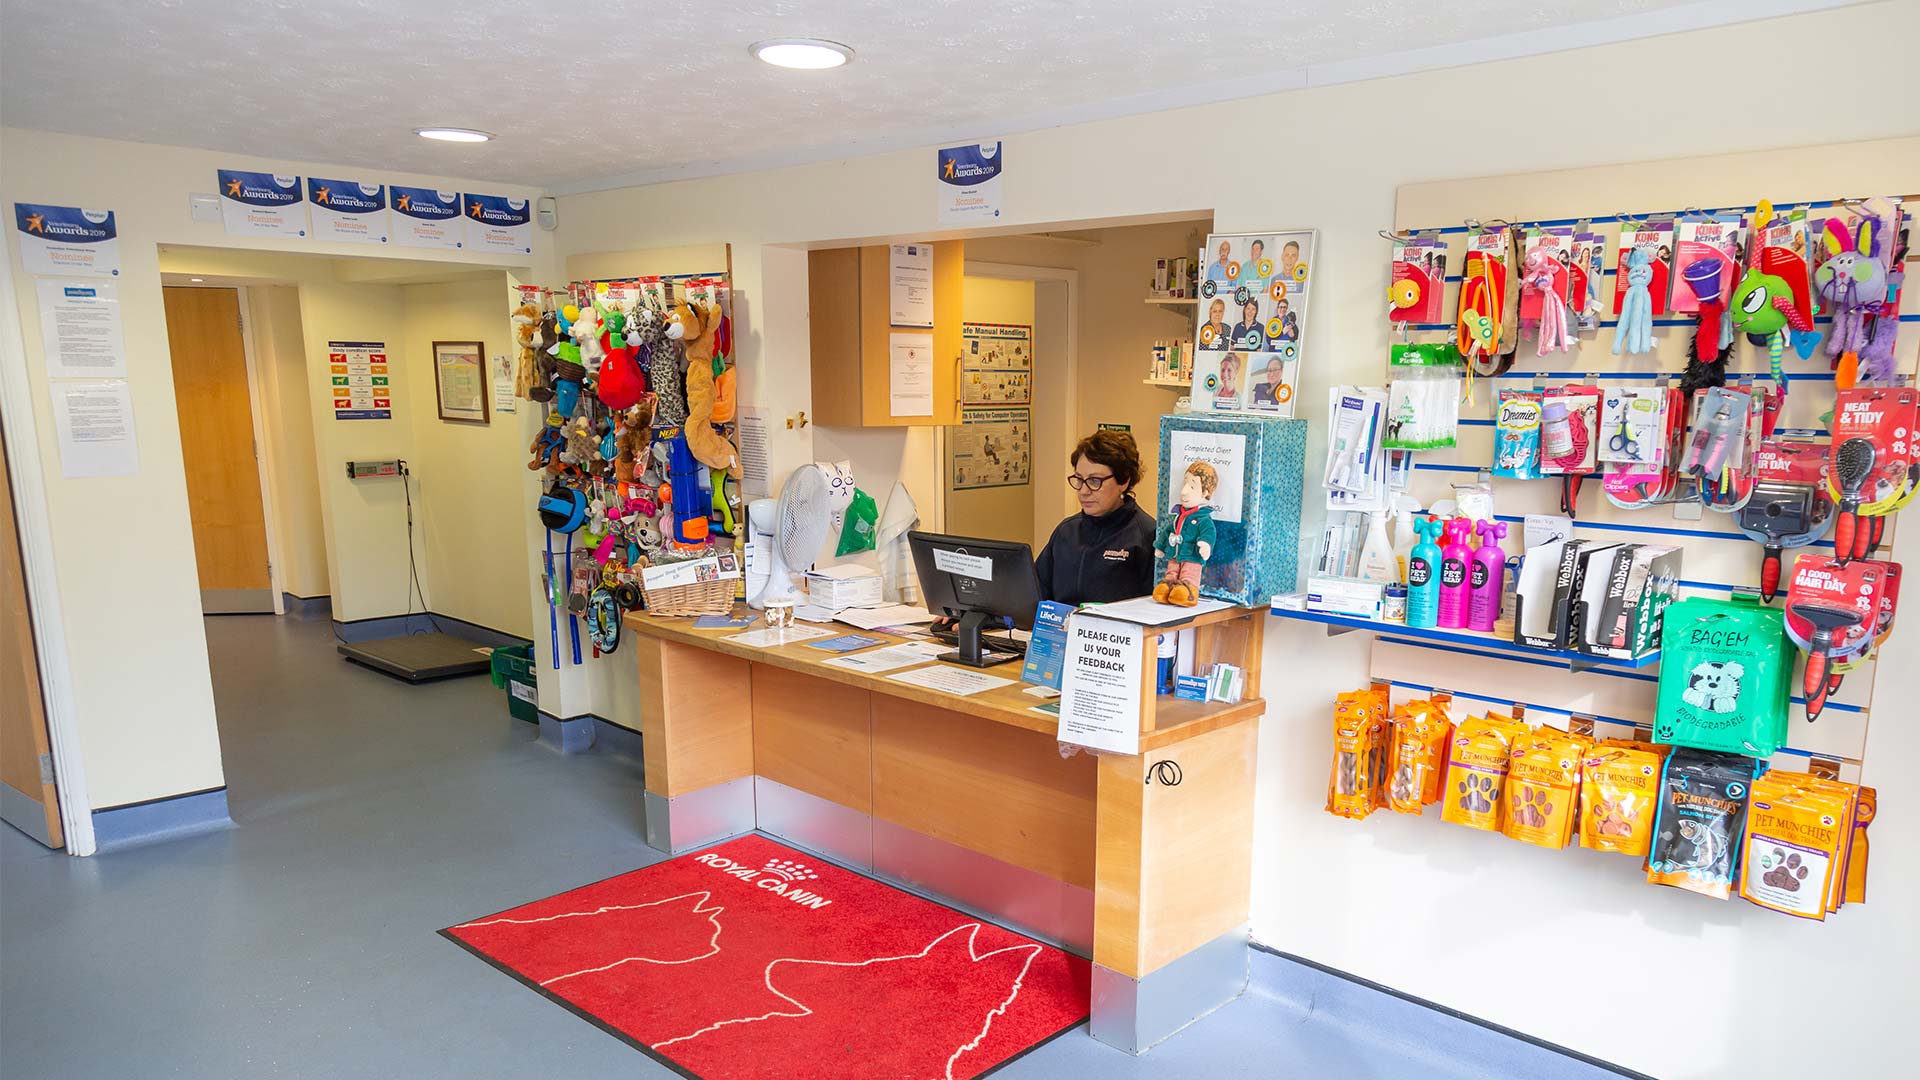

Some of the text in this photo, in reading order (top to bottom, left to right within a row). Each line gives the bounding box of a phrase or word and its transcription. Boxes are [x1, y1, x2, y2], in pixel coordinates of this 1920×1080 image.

[954, 167, 982, 178] Awards
[242, 190, 279, 200] Awards
[330, 198, 364, 207] Awards
[410, 205, 442, 214] Awards
[482, 211, 512, 221] Awards
[45, 224, 89, 236] Awards
[1695, 226, 1723, 235] KONG
[1539, 237, 1560, 246] KONG
[1635, 232, 1659, 242] KONG
[1694, 235, 1721, 243] Active
[1404, 248, 1422, 256] KONG
[1571, 243, 1581, 252] NG
[999, 328, 1026, 337] Handling
[1844, 402, 1871, 412] NEAT
[972, 412, 985, 420] Safety
[1502, 408, 1537, 422] Dreamies
[1840, 411, 1884, 424] & TIDY
[658, 427, 678, 439] NERF
[1184, 444, 1214, 453] Completed
[1213, 457, 1232, 466] Survey
[1759, 452, 1776, 460] OOD
[1758, 458, 1791, 472] IR DAY
[1410, 569, 1426, 577] PET
[1557, 547, 1575, 588] Webbox
[1443, 570, 1461, 578] PET
[1609, 558, 1631, 598] Webbox
[1799, 568, 1831, 579] A GOOD
[1795, 576, 1847, 594] HAIR DAY
[1040, 611, 1062, 622] LifeCare
[1635, 574, 1654, 656] Webbox
[1077, 628, 1131, 645] PLEASE GIVE
[1526, 637, 1550, 647] Webbox
[1690, 629, 1750, 647] BAG'EM
[1084, 643, 1121, 658] US YOUR
[1591, 645, 1609, 656] Webb
[1078, 656, 1125, 672] FEEDBACK
[1676, 707, 1746, 730] BIODEGRADABLE
[1460, 750, 1510, 768] PET MUNCHIES
[1514, 762, 1528, 772] PET
[1529, 765, 1563, 782] MUNCHIES
[1608, 773, 1647, 788] MUNCHIES
[1671, 791, 1738, 815] PET MUNCHIES
[1680, 810, 1704, 818] SALMON
[1755, 814, 1832, 845] PET MUNCHIES
[694, 853, 832, 909] ROYAL CANIN
